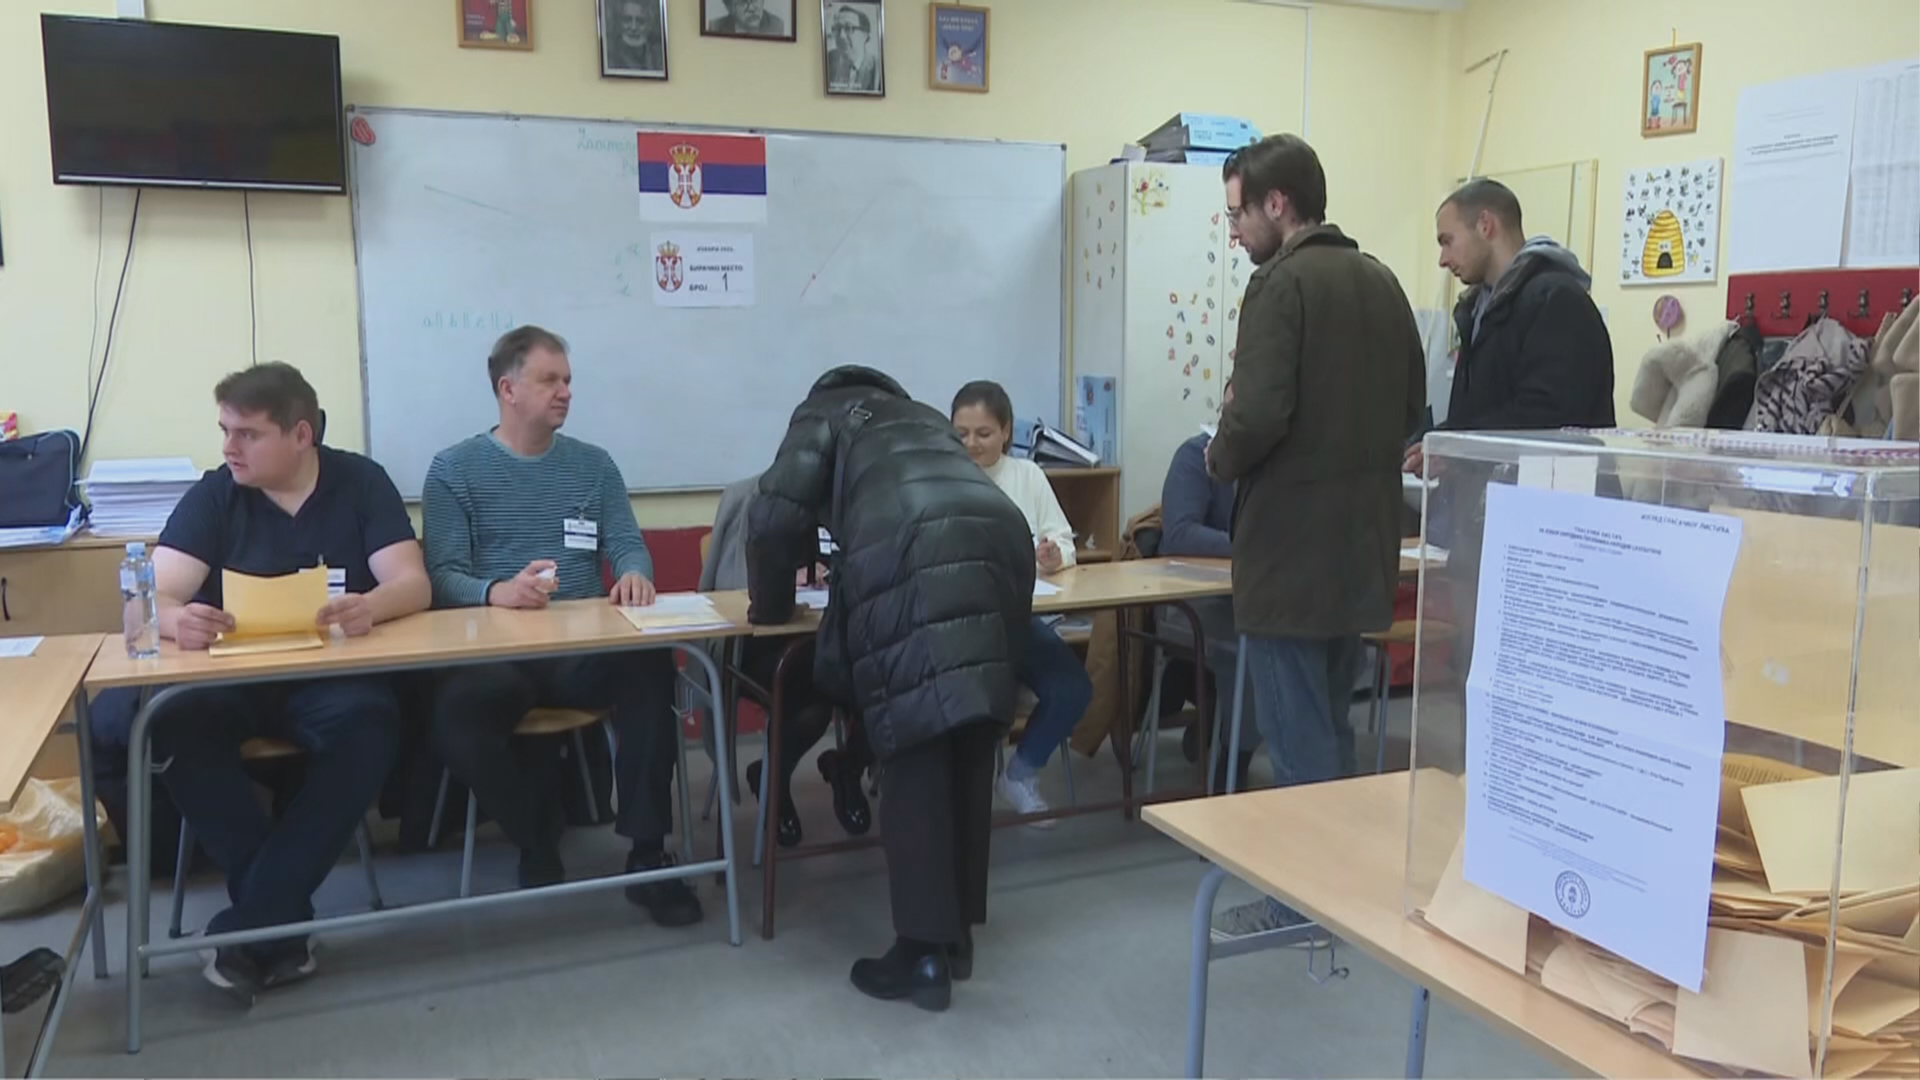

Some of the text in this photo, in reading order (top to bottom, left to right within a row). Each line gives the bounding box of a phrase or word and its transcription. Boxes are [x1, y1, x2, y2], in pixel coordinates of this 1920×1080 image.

[689, 264, 744, 272] БИРАЧКО МЕСТО
[689, 272, 728, 292] БРОЈ 1
